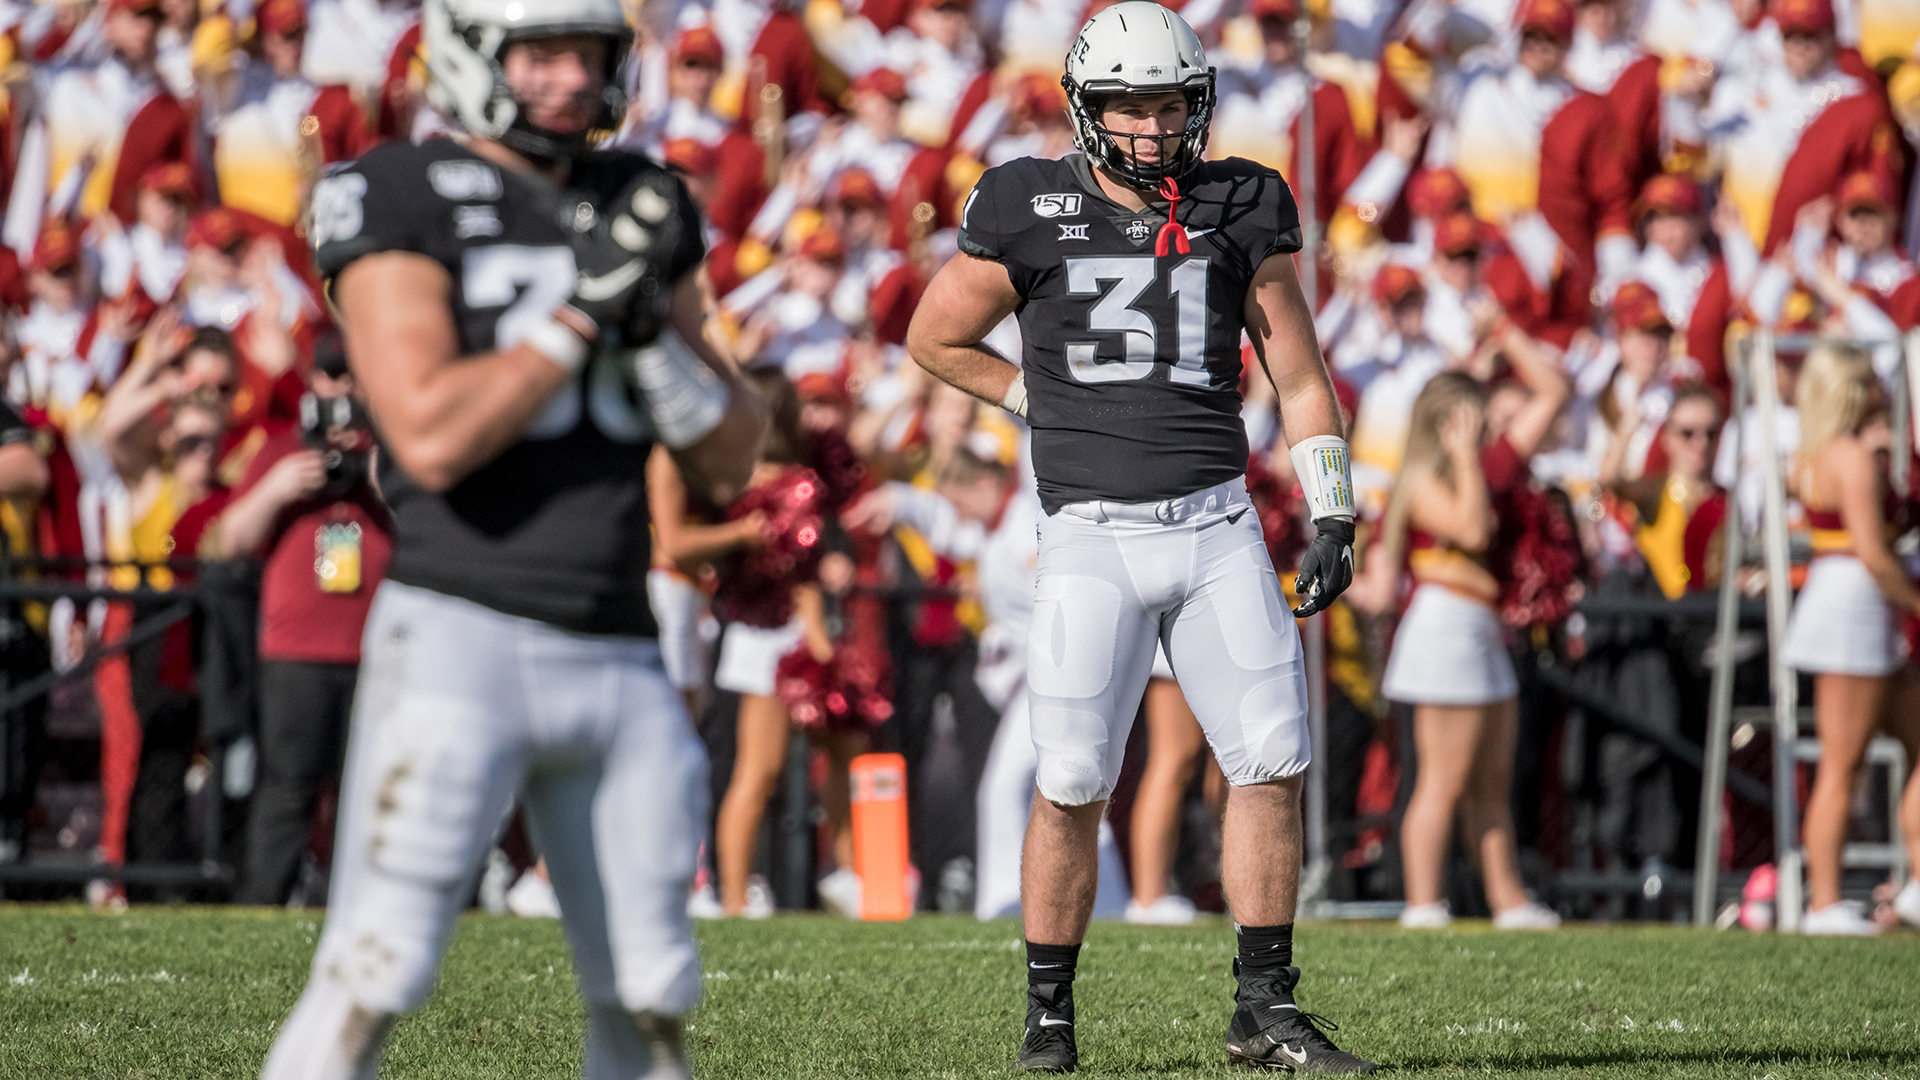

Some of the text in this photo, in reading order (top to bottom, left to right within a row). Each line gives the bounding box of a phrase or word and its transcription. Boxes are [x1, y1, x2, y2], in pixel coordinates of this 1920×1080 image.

[1030, 193, 1082, 218] 150
[1058, 224, 1090, 240] XII
[1125, 224, 1150, 236] STATE
[1062, 255, 1211, 386] 31
